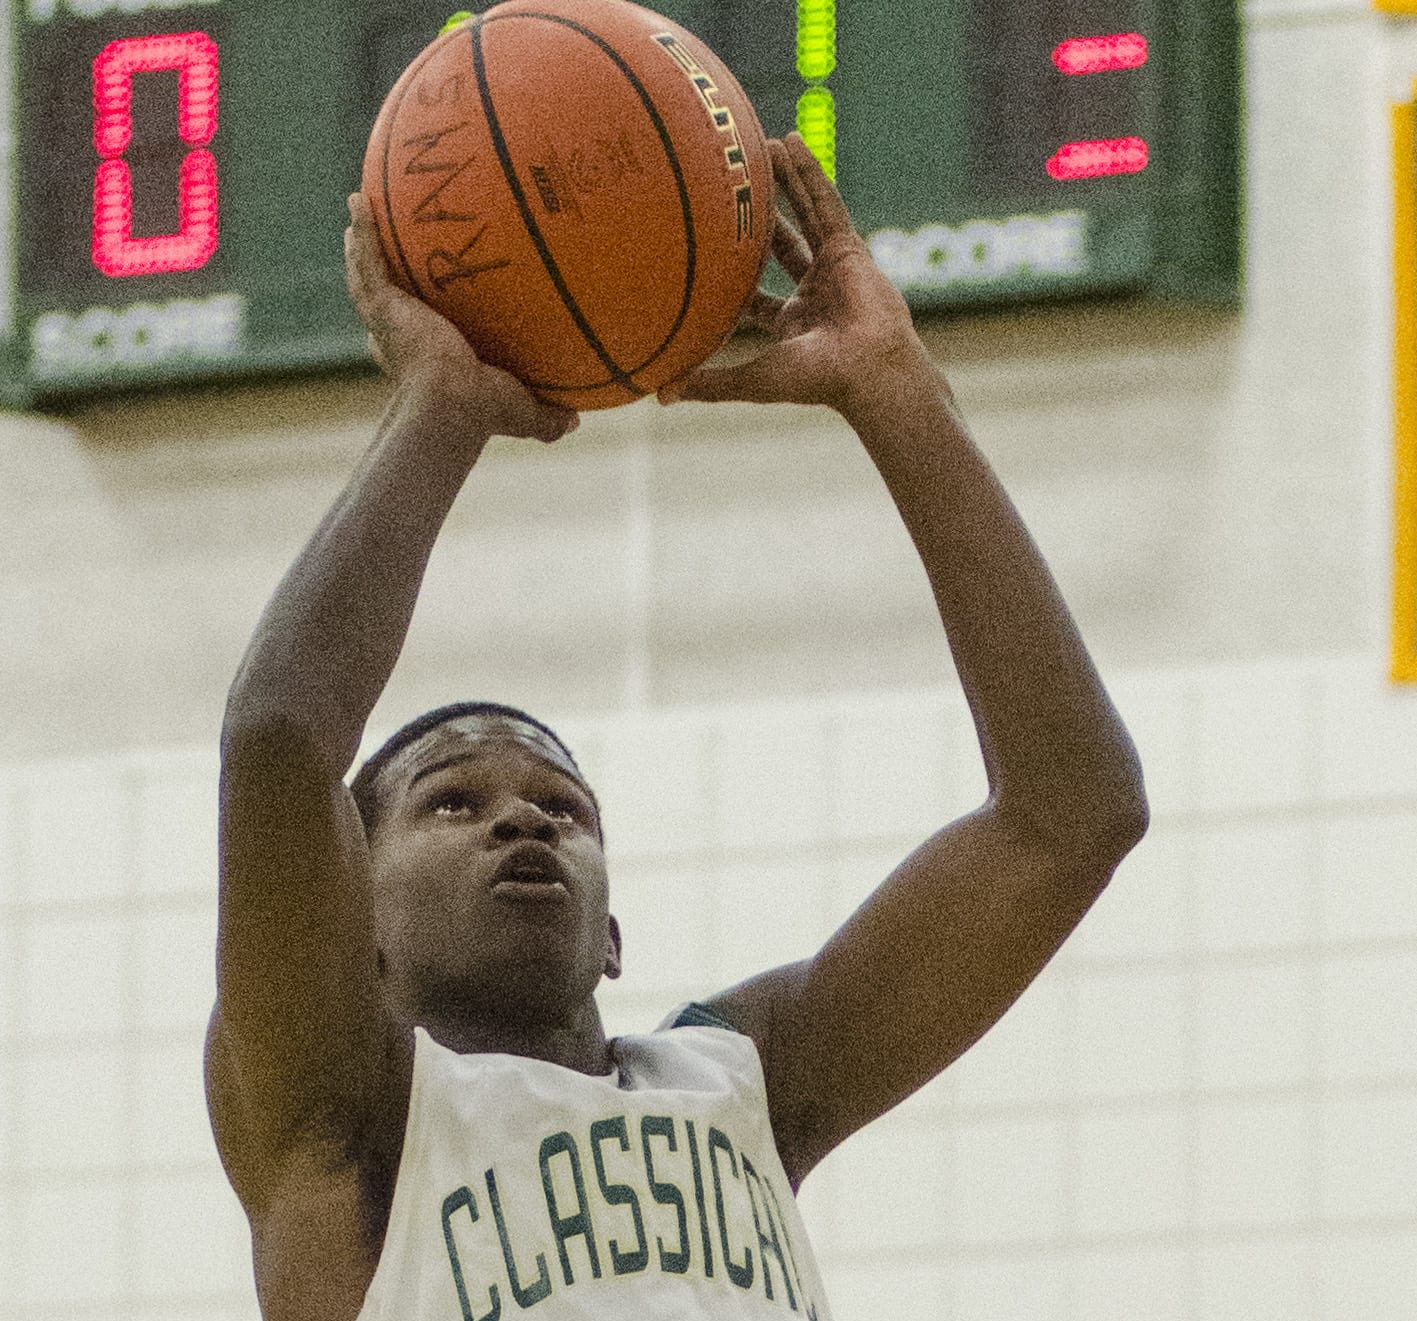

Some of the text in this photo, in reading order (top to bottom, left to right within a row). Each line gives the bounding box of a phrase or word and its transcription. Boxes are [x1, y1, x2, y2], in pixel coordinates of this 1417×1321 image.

[92, 30, 219, 278] 0
[651, 32, 754, 241] ELITE
[31, 293, 247, 370] SCORE
